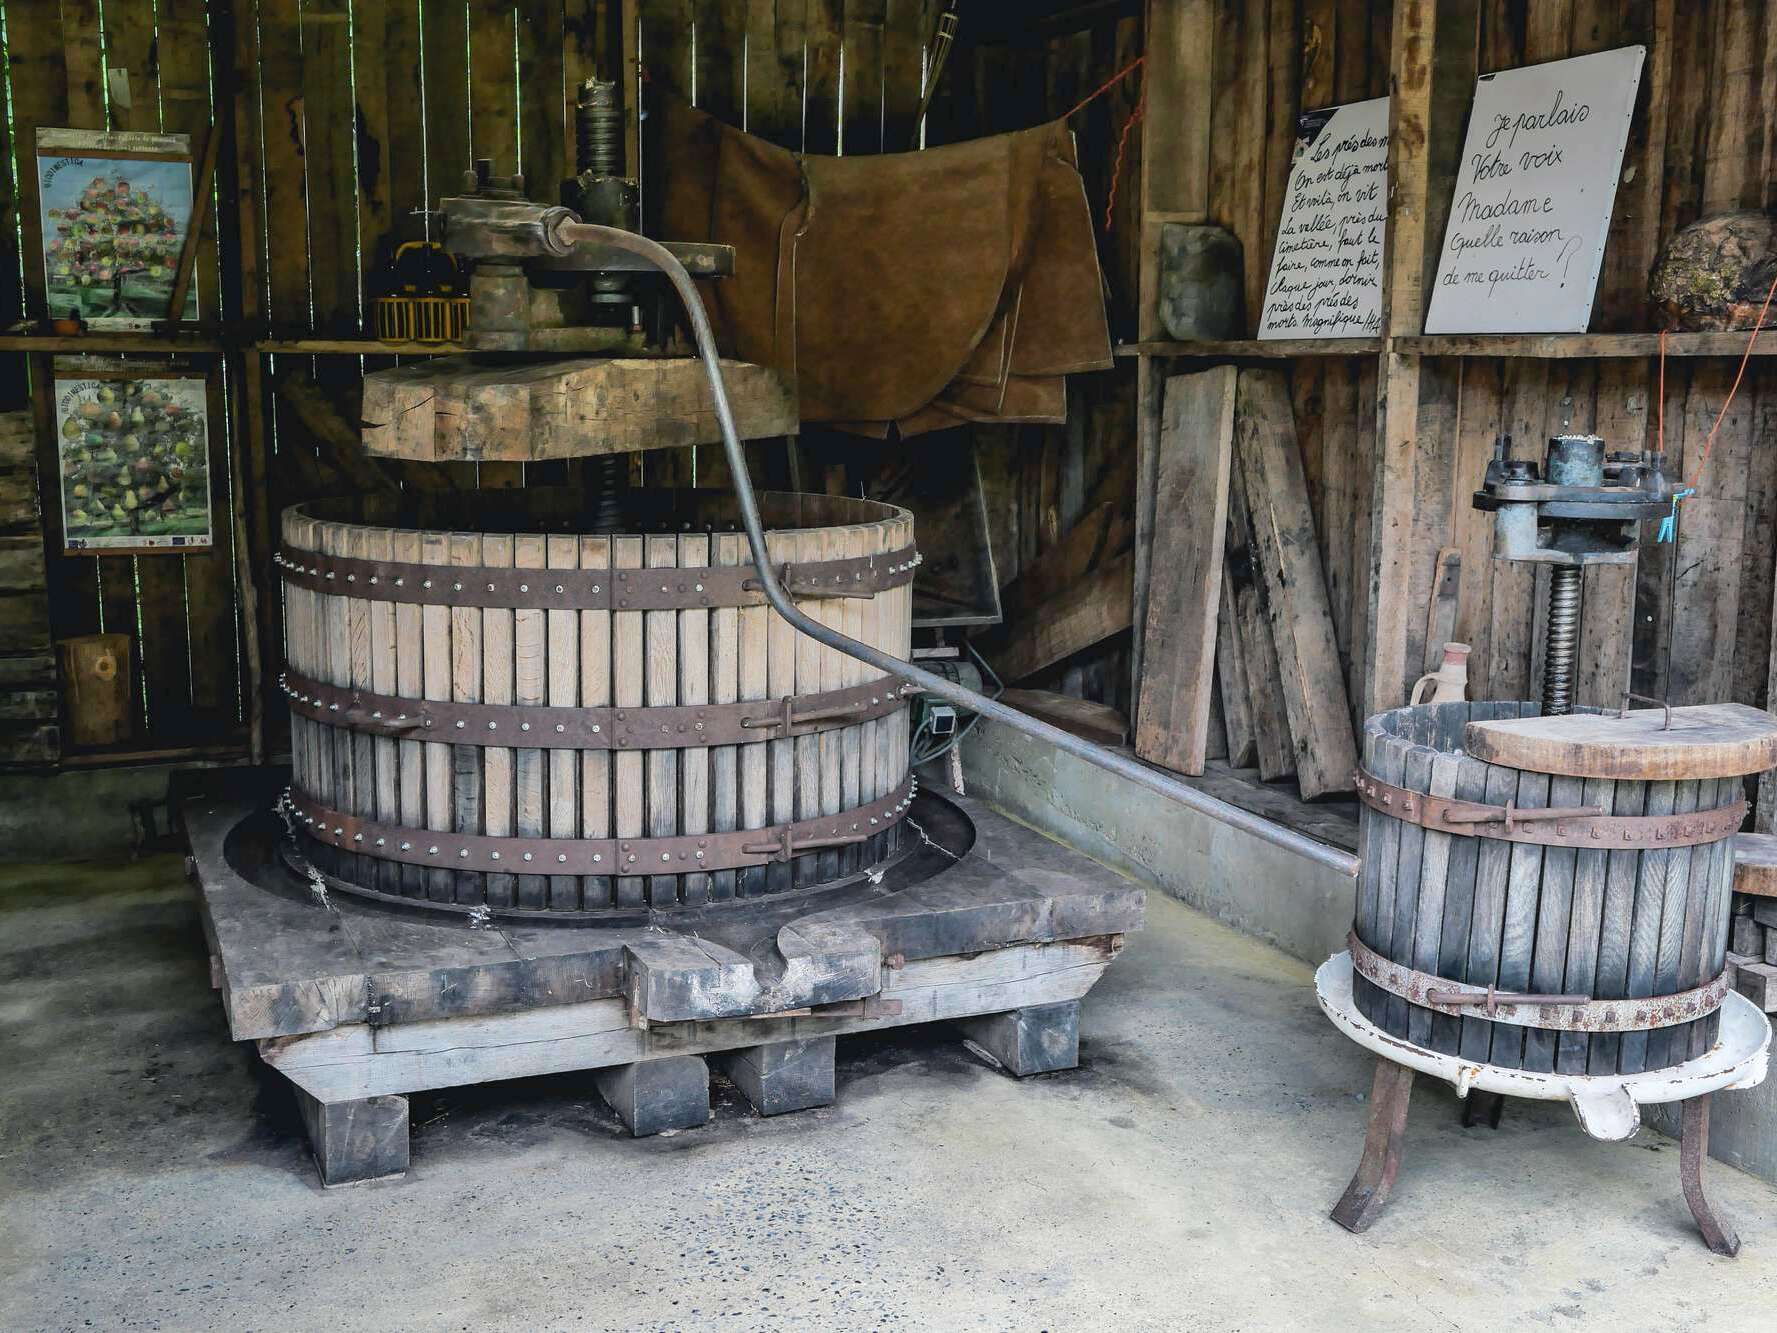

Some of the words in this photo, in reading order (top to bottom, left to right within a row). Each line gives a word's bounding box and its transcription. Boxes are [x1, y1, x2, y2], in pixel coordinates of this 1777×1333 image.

[1508, 89, 1591, 149] parlais
[1471, 150, 1513, 185] Votre
[1518, 144, 1564, 171] voix
[1337, 190, 1353, 202] on
[1355, 182, 1379, 202] vit
[1457, 188, 1554, 224] Madame
[1509, 227, 1563, 245] raison
[1310, 257, 1341, 269] comme
[1442, 262, 1459, 286] de
[1463, 270, 1485, 283] me
[1487, 256, 1551, 298] quitter
